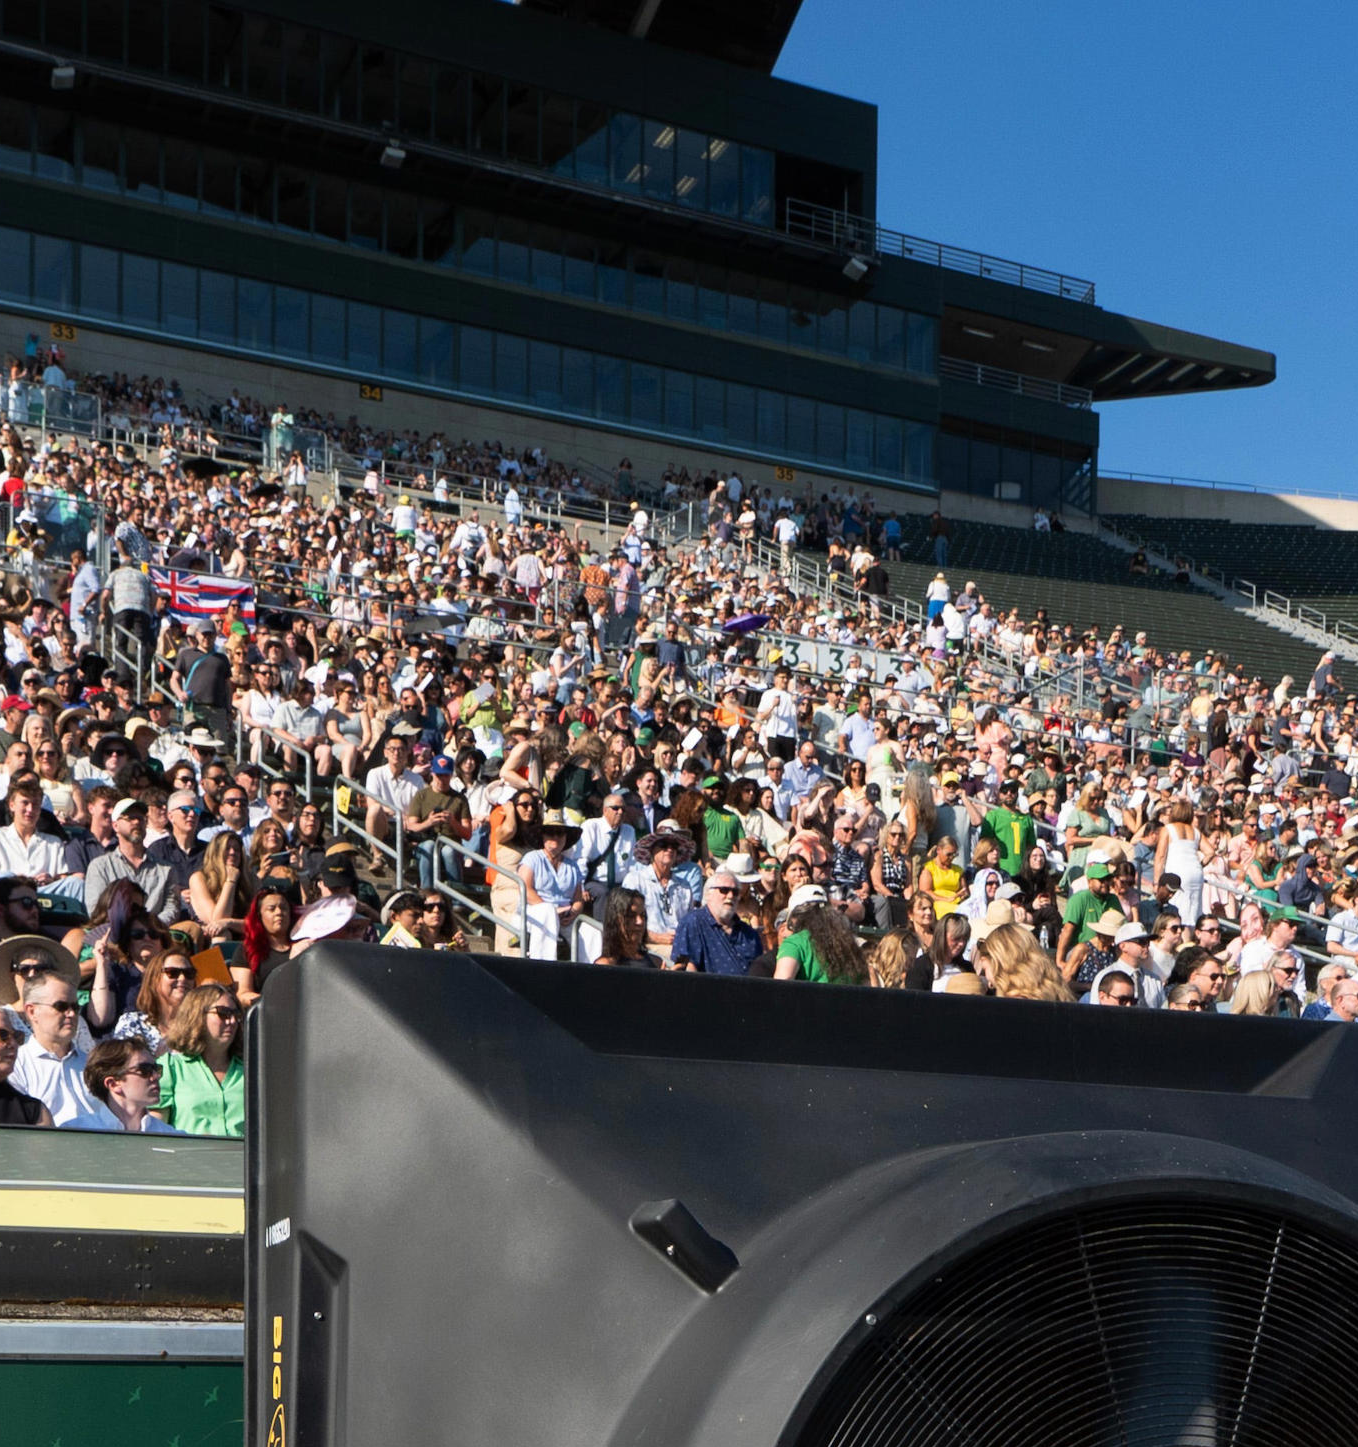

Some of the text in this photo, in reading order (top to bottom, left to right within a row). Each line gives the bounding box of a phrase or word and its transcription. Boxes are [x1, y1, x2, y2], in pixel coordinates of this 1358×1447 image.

[53, 324, 75, 340] 33
[361, 384, 381, 401] 34
[1010, 821, 1021, 855] 1
[273, 1316, 283, 1400] BIG
